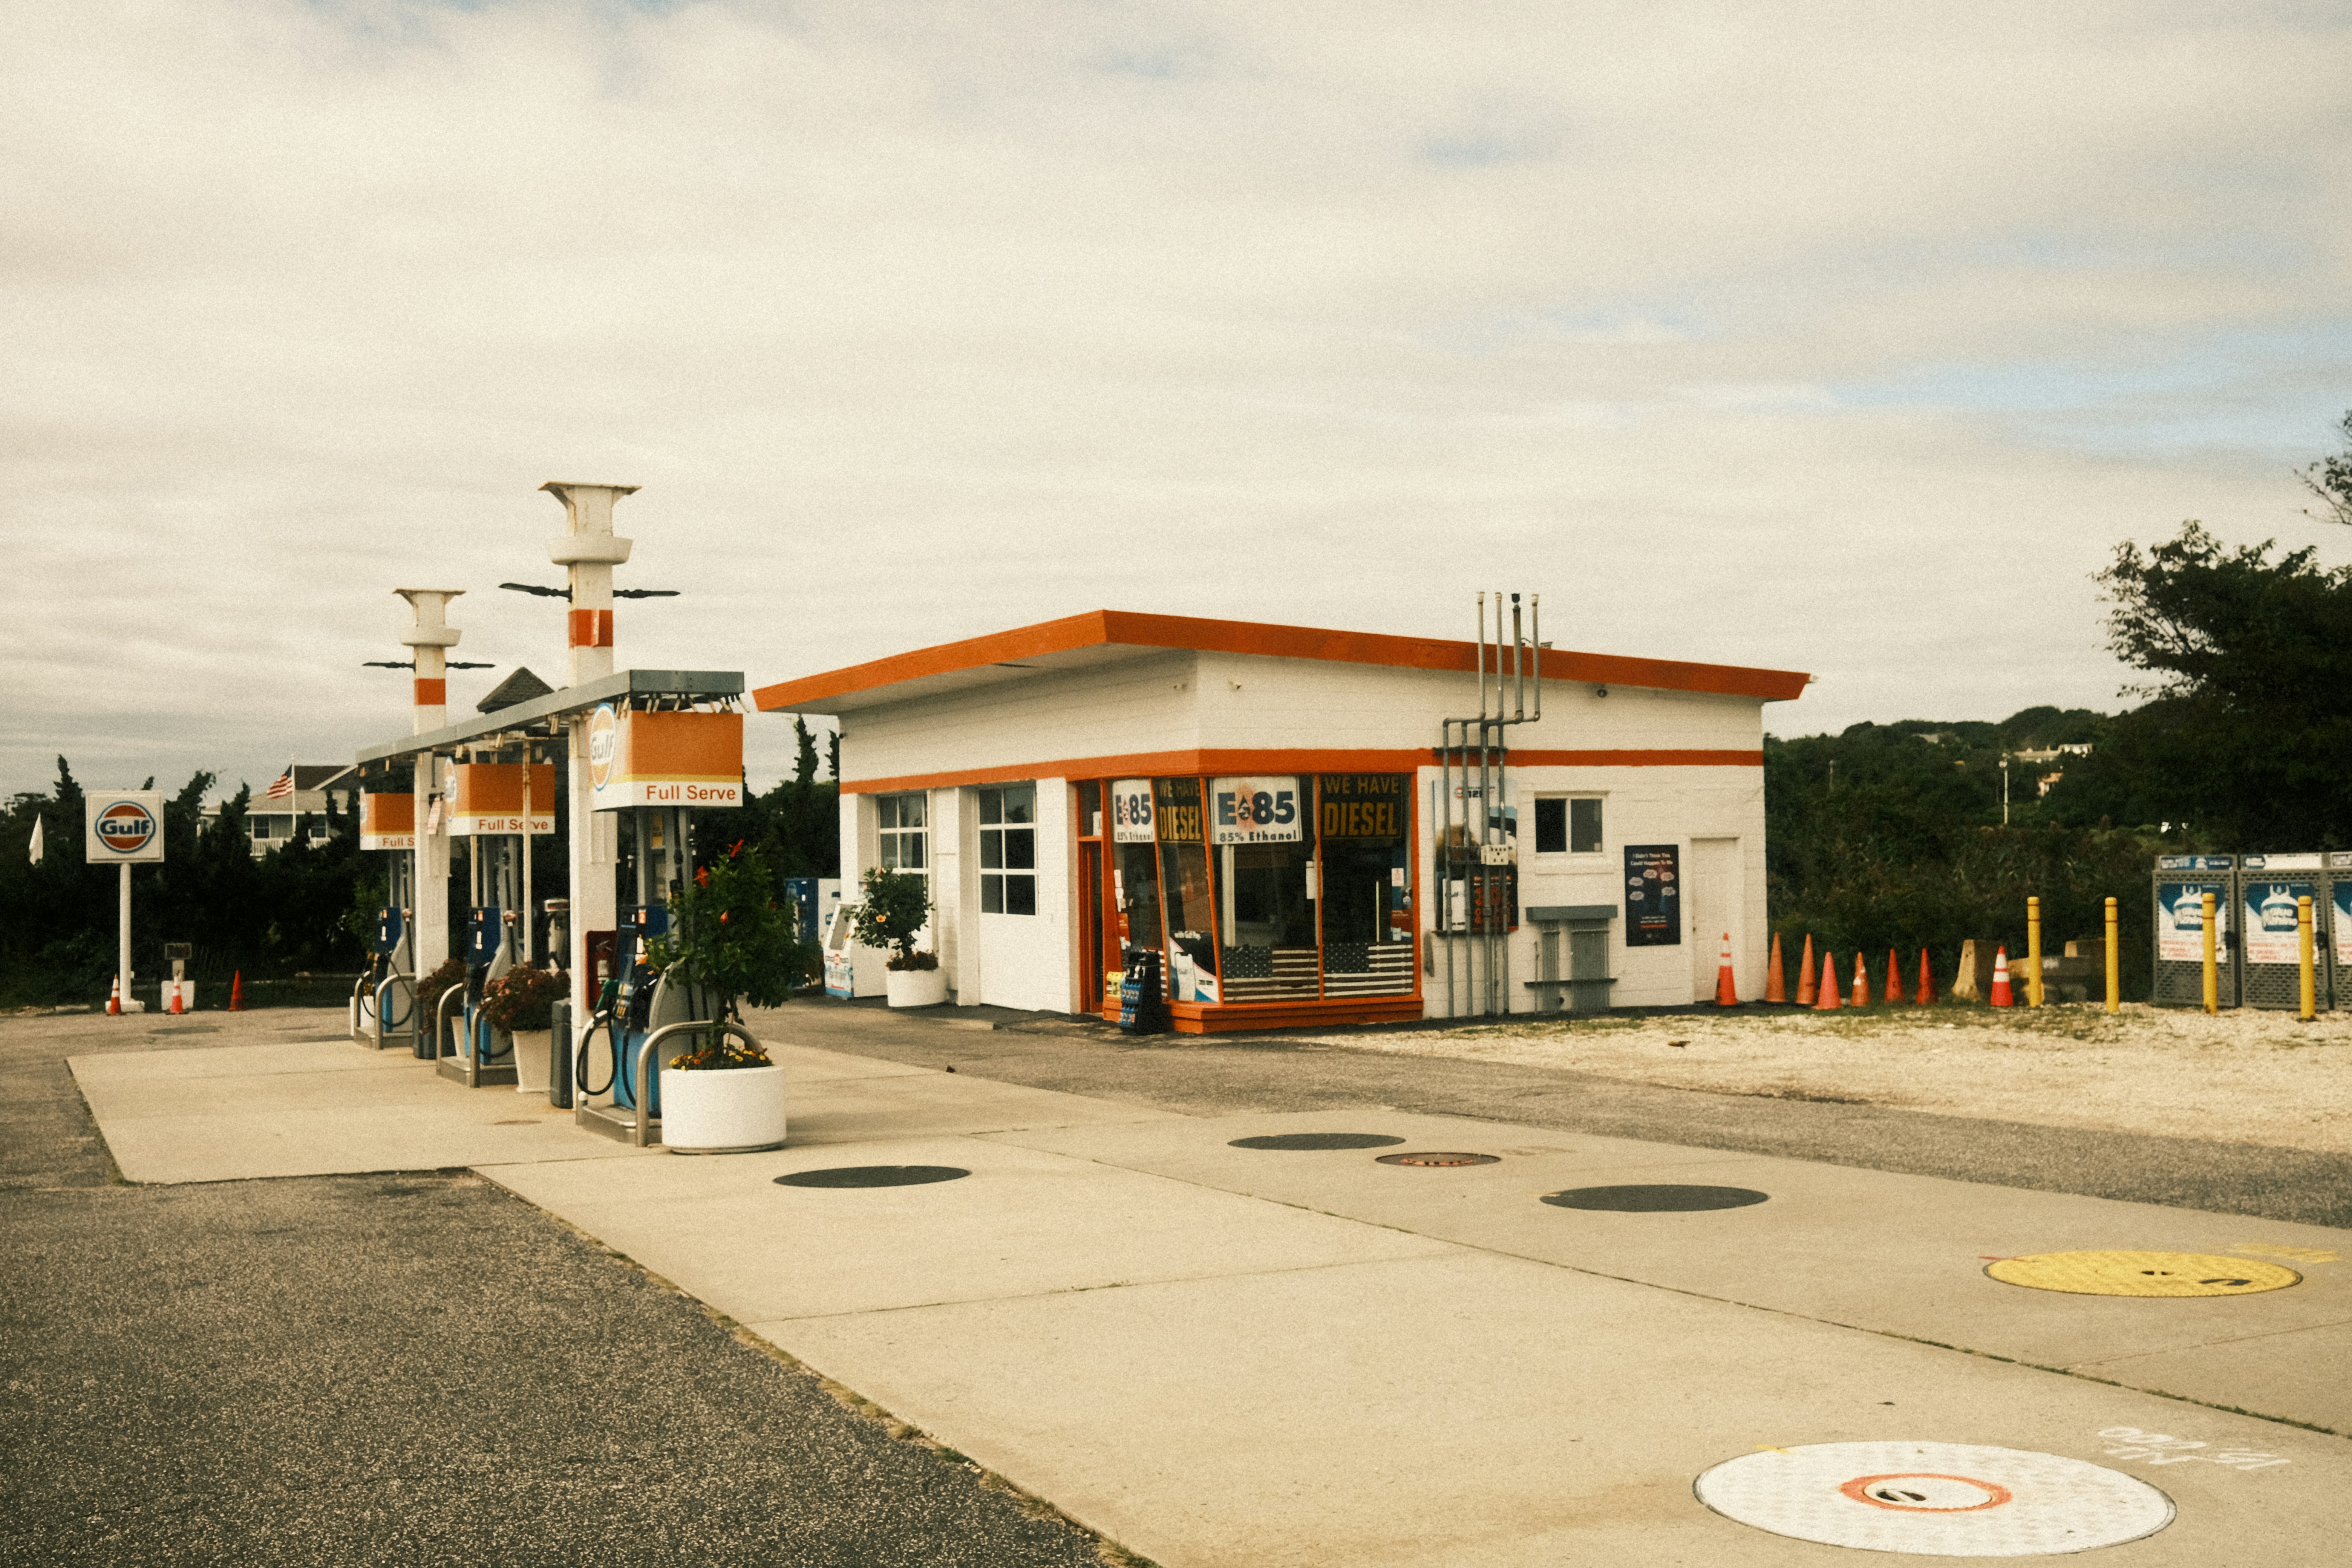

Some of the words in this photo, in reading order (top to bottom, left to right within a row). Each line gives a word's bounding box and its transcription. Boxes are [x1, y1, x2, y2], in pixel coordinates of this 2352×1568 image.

[646, 785, 680, 799] Full
[687, 785, 736, 800] Serve
[1159, 781, 1173, 797] WE
[1176, 780, 1200, 797] HAVE
[1324, 776, 1351, 794] WE
[1357, 776, 1399, 794] HAVE
[100, 819, 150, 835] Gulf
[479, 819, 504, 830] Full
[1160, 805, 1201, 840] DIESEL
[1324, 802, 1397, 836] DIESEL
[383, 838, 403, 847] Full
[1220, 832, 1244, 842] 85%
[1249, 830, 1297, 841] Ethanol
